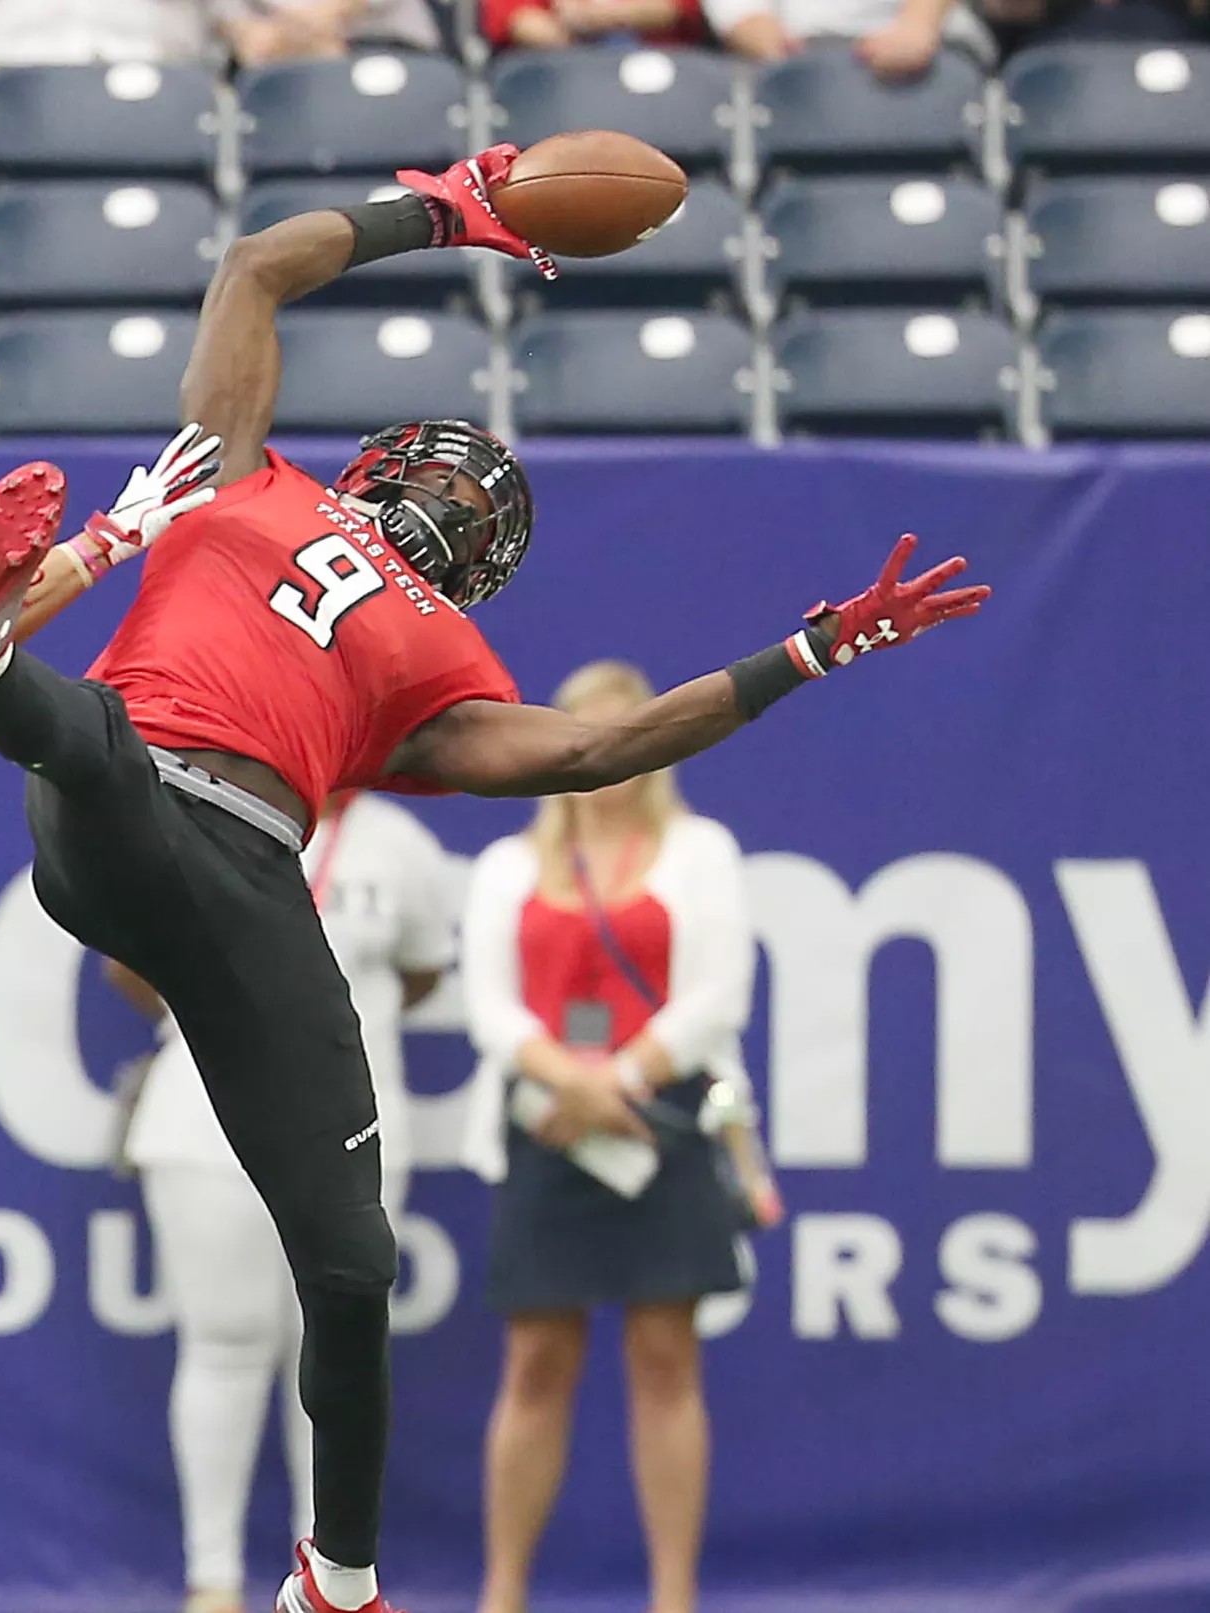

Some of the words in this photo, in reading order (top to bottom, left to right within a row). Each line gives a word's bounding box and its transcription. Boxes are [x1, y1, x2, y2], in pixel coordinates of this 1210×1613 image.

[269, 532, 387, 651] 9
[316, 502, 385, 559] TEXAS
[384, 558, 437, 616] TECH
